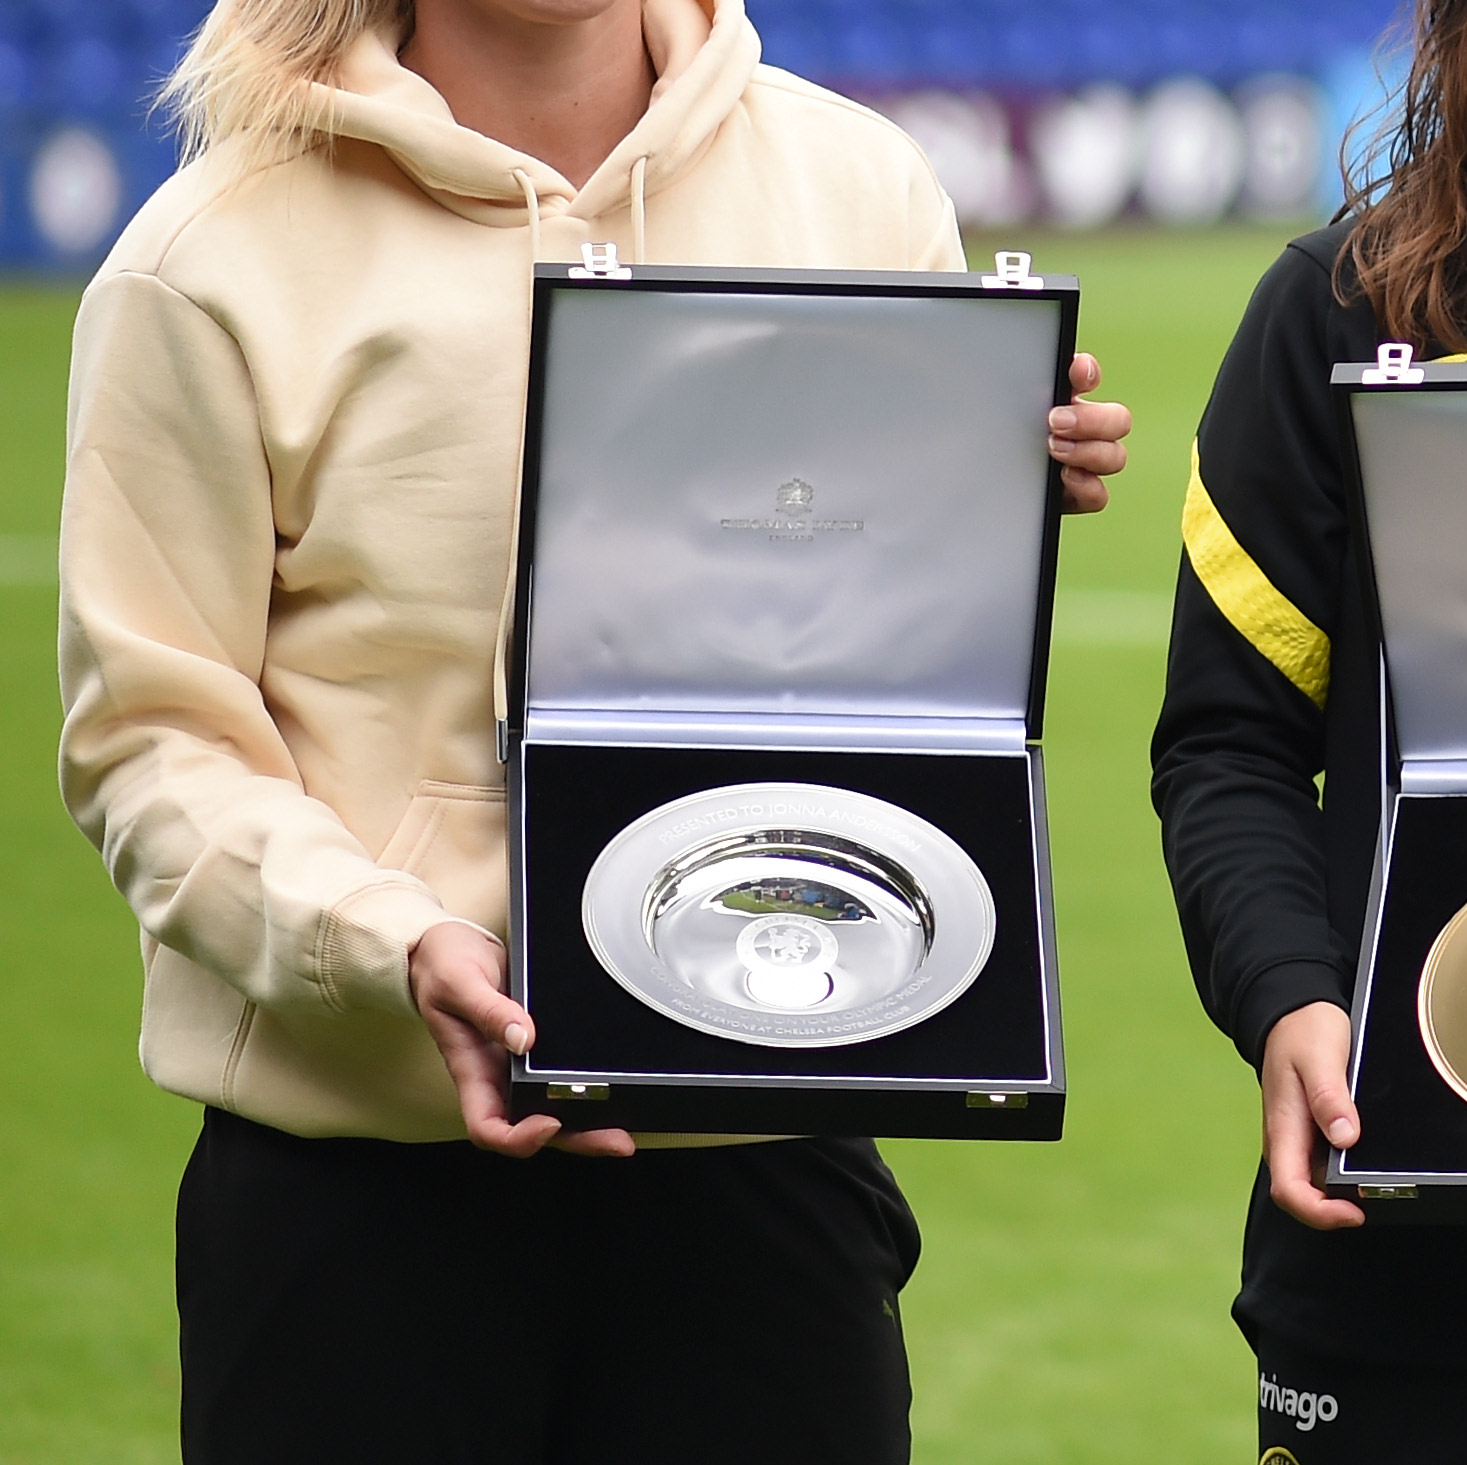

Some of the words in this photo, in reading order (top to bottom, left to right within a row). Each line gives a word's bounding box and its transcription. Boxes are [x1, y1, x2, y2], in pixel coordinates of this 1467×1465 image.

[659, 808, 738, 845] PRESENTED
[740, 804, 764, 817] TO
[769, 803, 826, 818] JONNA
[671, 998, 701, 1014] FROM
[775, 1027, 825, 1036] CHELSEA
[827, 1017, 884, 1033] FOOTBALL
[841, 996, 898, 1020] OLYMPIC
[897, 976, 933, 1001] MEDAL
[1259, 1372, 1339, 1432] trivago
